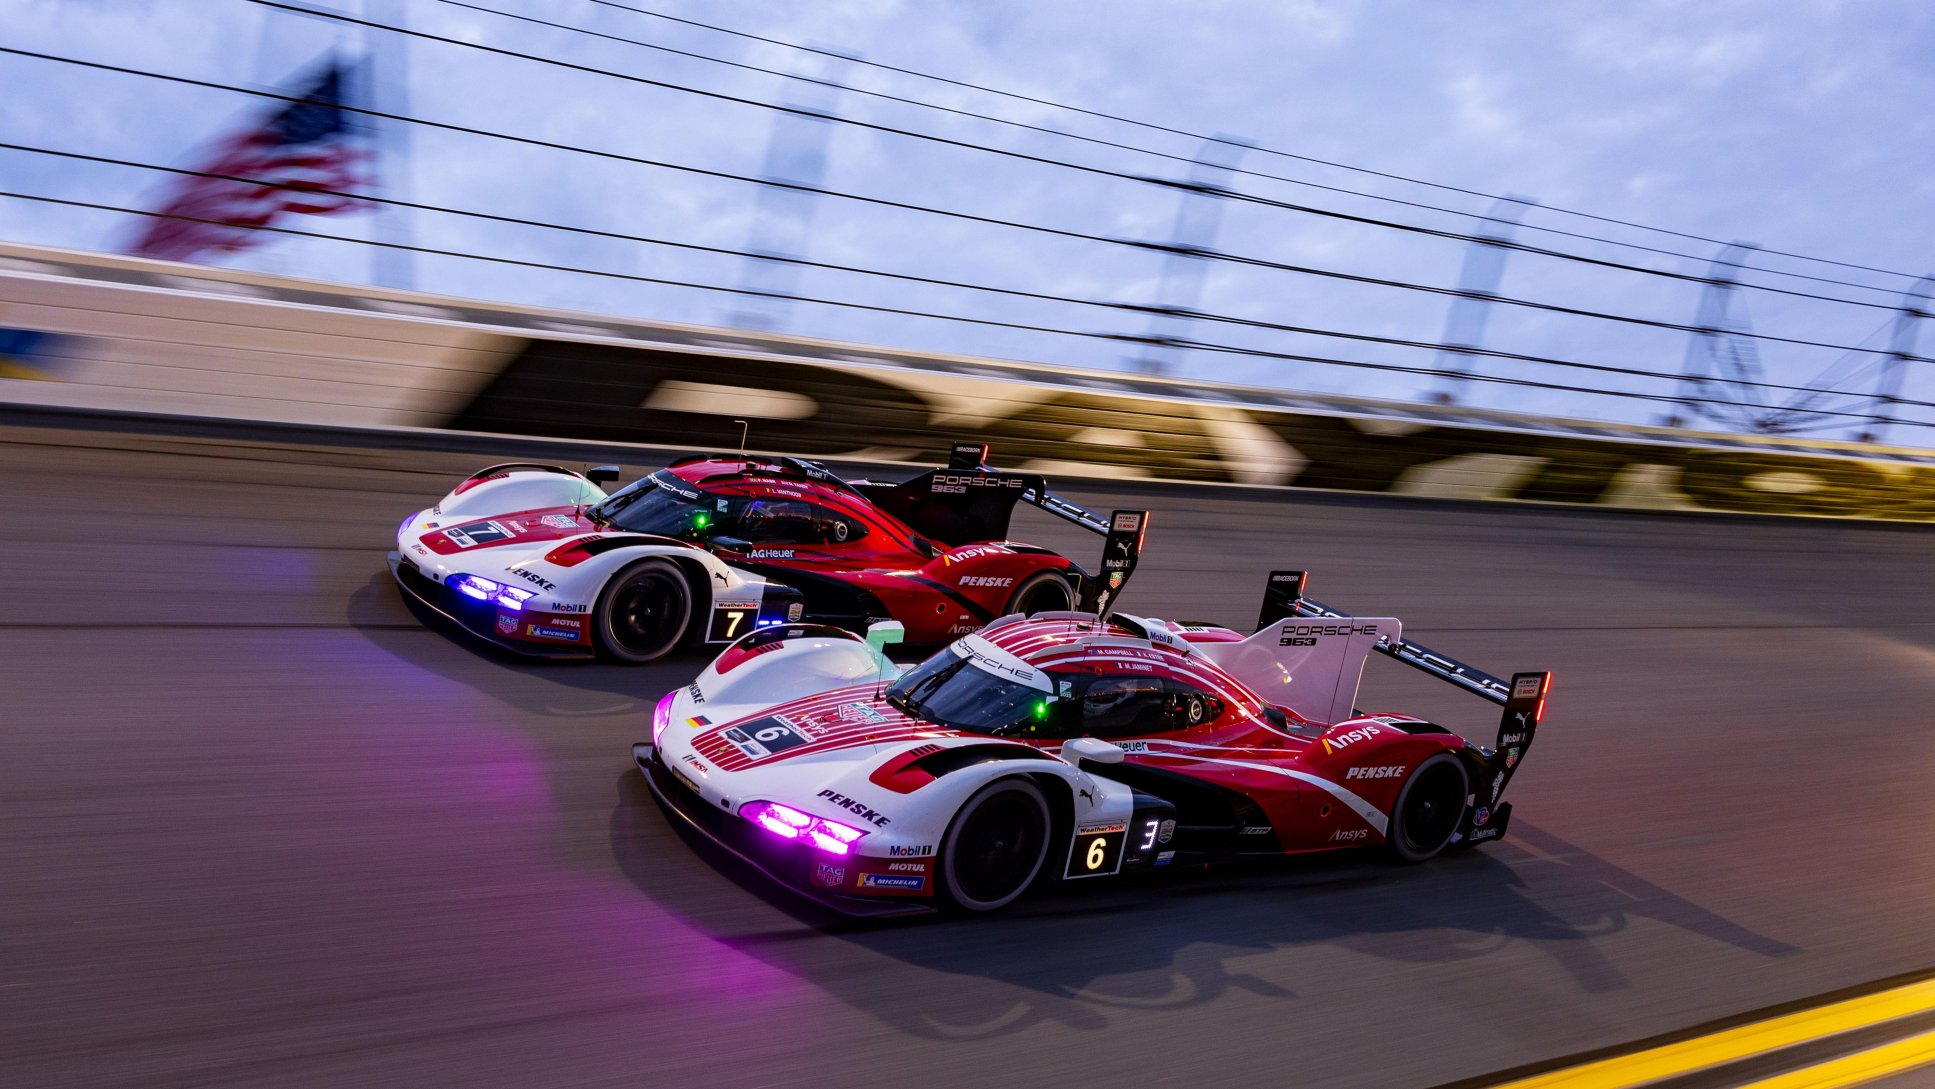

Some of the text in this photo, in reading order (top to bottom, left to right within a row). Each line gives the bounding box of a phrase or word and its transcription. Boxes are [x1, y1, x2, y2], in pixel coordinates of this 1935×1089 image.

[932, 475, 1023, 488] PORSCHE
[931, 485, 967, 494] 963
[467, 526, 500, 536] 7
[959, 576, 1013, 587] PENSKE
[552, 602, 577, 612] Mobil
[551, 618, 581, 628] MOTUL
[726, 612, 744, 638] 7
[542, 630, 575, 638] MICHELIN
[1281, 625, 1378, 636] PORSCHE
[1150, 631, 1167, 642] Mobil
[1279, 637, 1318, 647] 963
[754, 726, 790, 742] 6
[1321, 726, 1381, 756] Ansys
[1346, 766, 1406, 779] PENSKE
[817, 789, 891, 828] PENSKE
[1080, 825, 1124, 834] WeatherTech
[1141, 820, 1159, 850] 3
[1328, 829, 1368, 841] Ansys
[889, 845, 932, 856] Mobil 1
[1086, 837, 1107, 870] 6
[821, 864, 842, 876] TAG
[888, 863, 925, 872] MOTUL
[877, 878, 918, 886] MICHELIN
